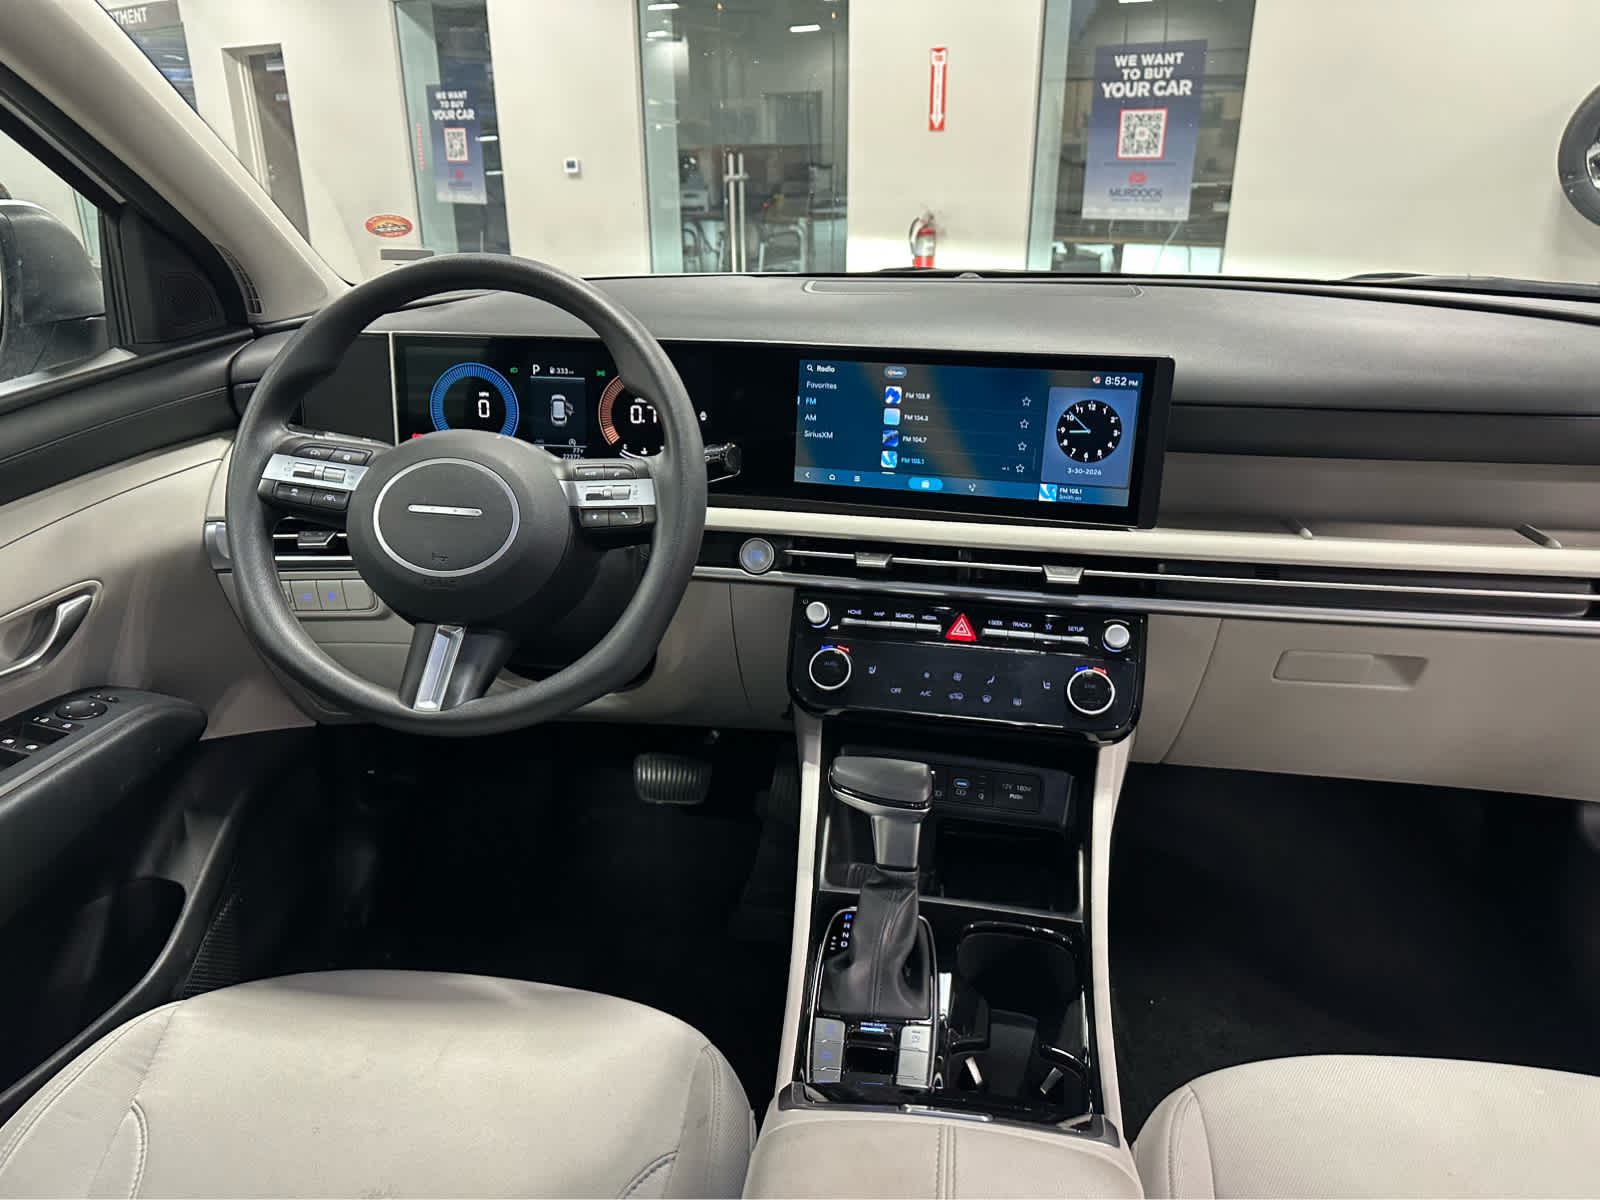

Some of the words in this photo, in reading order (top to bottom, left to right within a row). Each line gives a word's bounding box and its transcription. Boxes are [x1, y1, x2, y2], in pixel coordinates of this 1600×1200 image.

[109, 7, 147, 25] TMENT
[1114, 54, 1137, 67] WE
[1141, 52, 1184, 66] WANT
[1122, 68, 1141, 80] TO
[1144, 67, 1174, 79] BUY
[1102, 82, 1150, 98] YOUR
[1153, 80, 1192, 96] CAR
[436, 91, 446, 99] WE
[447, 90, 467, 99] WANT
[450, 100, 464, 108] BUY
[432, 110, 456, 120] YOUR
[456, 109, 475, 120] CAR
[1109, 188, 1163, 198] MURDOCK
[532, 364, 540, 375] P
[816, 365, 836, 373] Radio
[806, 380, 837, 390] Favorites
[1105, 376, 1127, 386] 8:52
[805, 397, 816, 405] FM
[478, 399, 490, 418] 0
[1103, 407, 1107, 415] 1
[630, 405, 657, 424] 0.7
[805, 413, 816, 421] AM
[804, 430, 833, 439] SiriusXM
[1067, 467, 1102, 476] 3-30-2026
[845, 913, 852, 921] P
